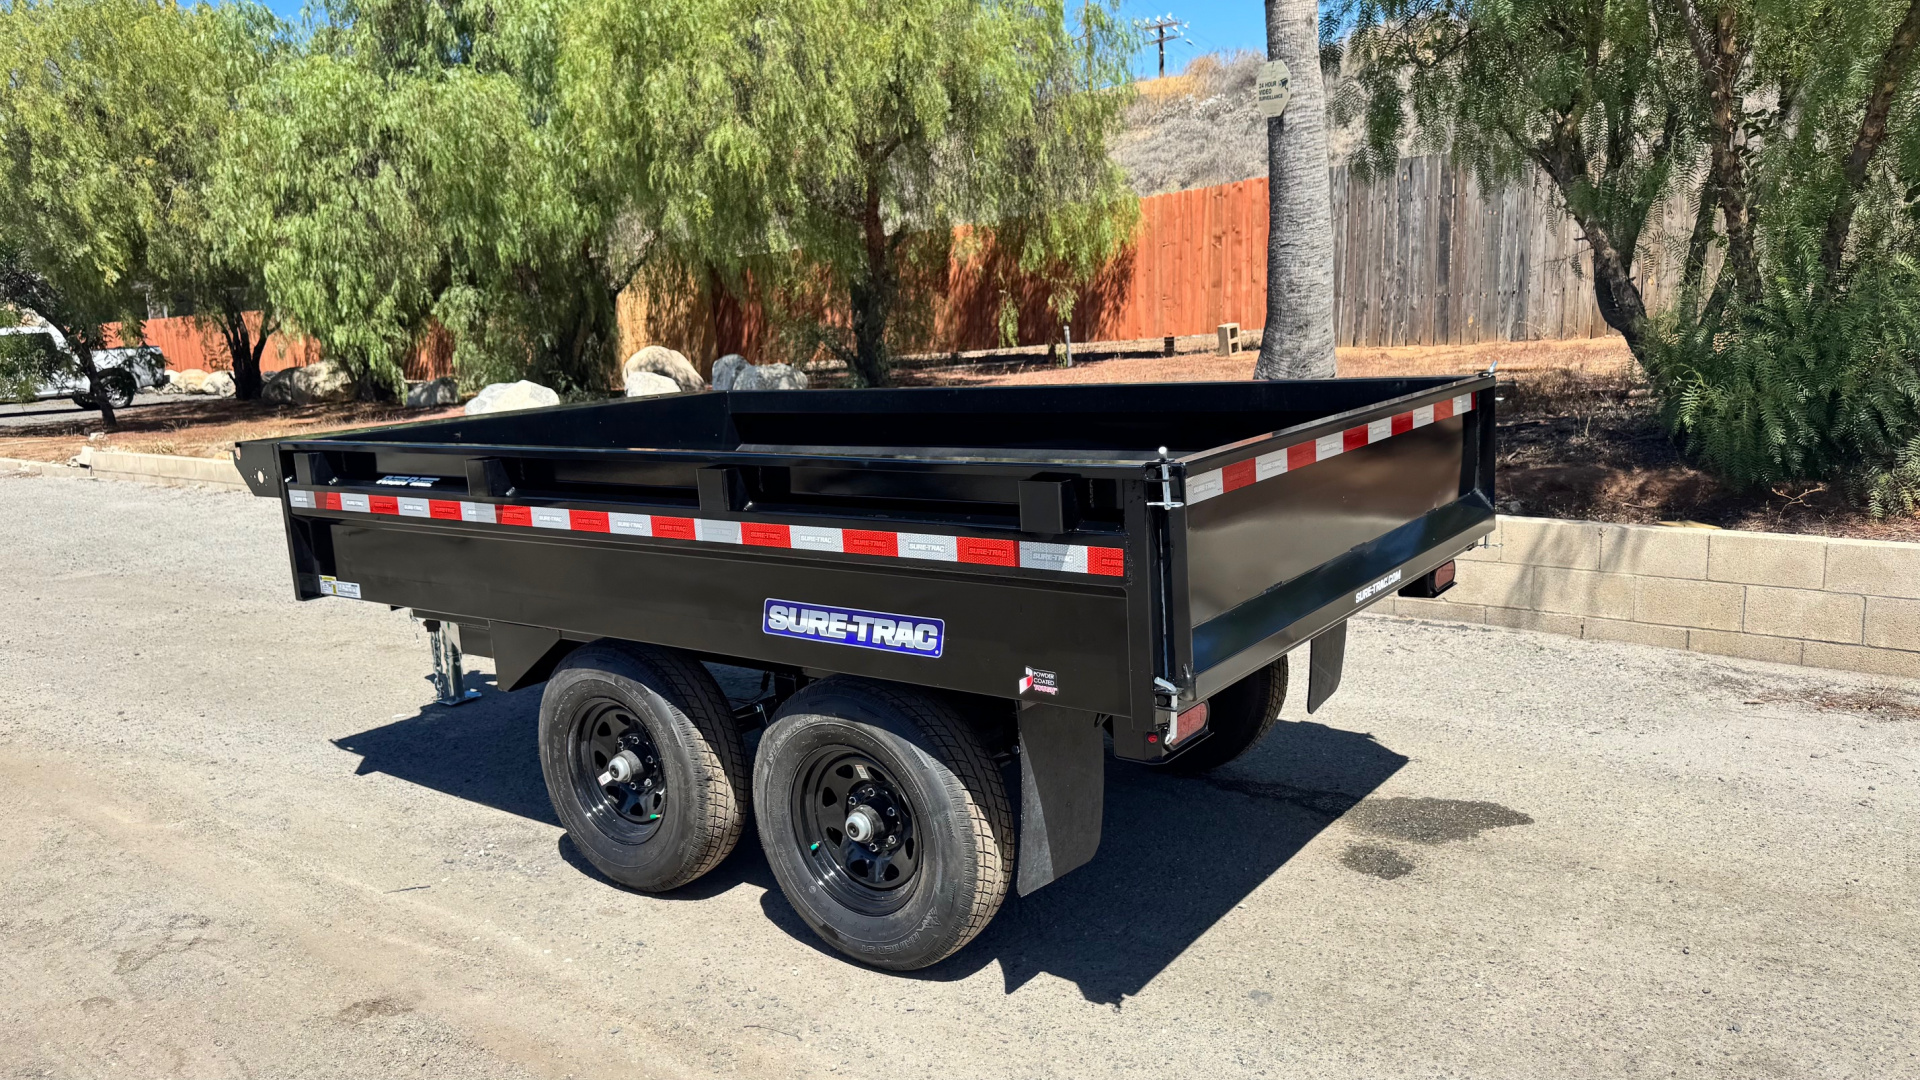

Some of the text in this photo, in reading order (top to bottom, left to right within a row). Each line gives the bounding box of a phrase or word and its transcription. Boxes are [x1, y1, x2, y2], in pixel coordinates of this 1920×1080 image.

[799, 535, 832, 544] SURE-TRAC
[853, 539, 886, 548] SURE-TRAC
[909, 543, 945, 552] SURE-TRAC
[968, 547, 1007, 558] SURE-TRAC
[1032, 552, 1074, 563] SURE-TRAC
[1355, 569, 1402, 603] SURE-TRAC.COM
[768, 604, 938, 651] SURE-TRAC
[1033, 671, 1055, 680] POWDER
[1033, 678, 1055, 686] COATED
